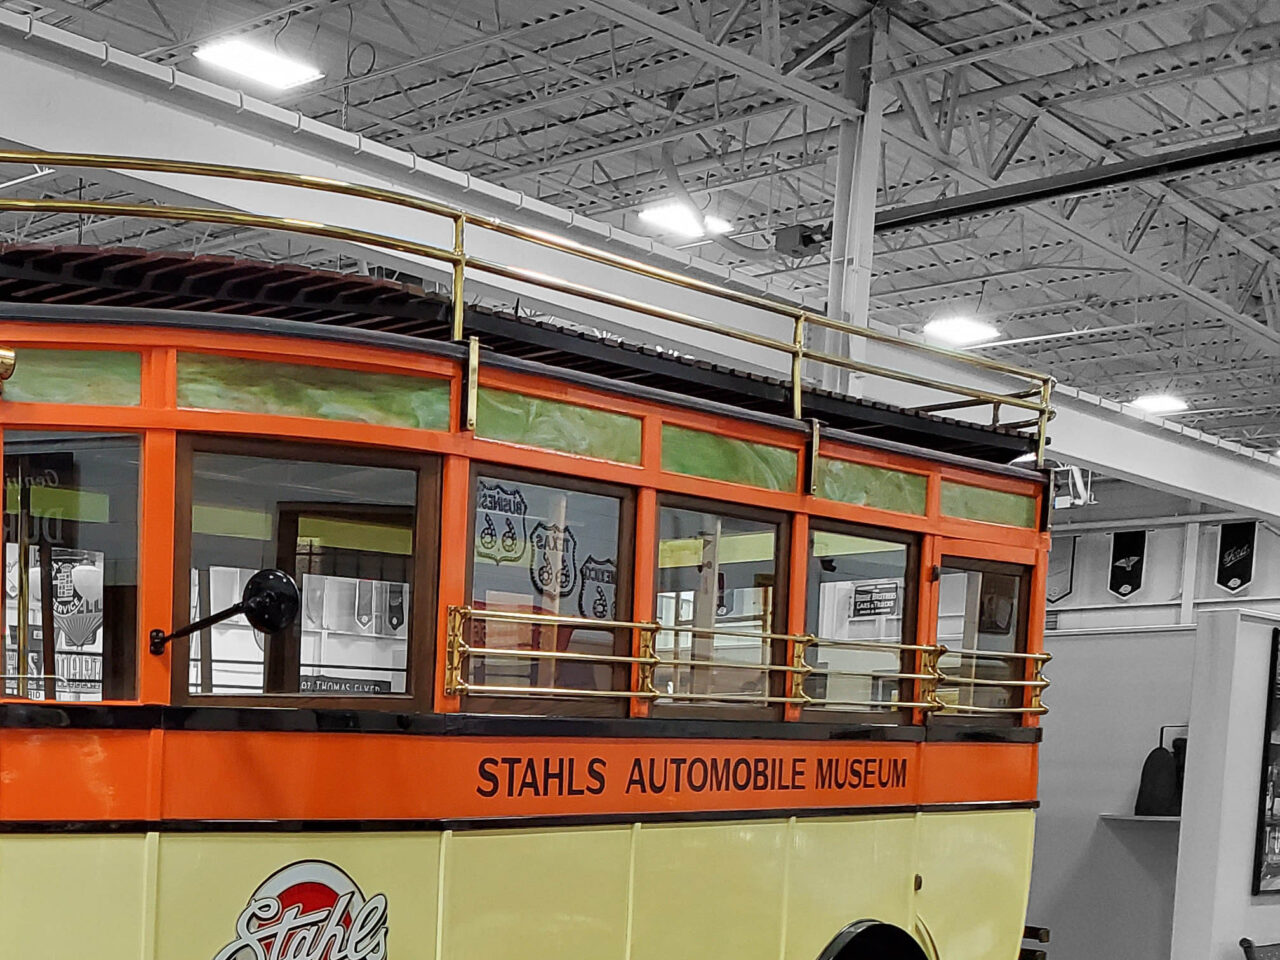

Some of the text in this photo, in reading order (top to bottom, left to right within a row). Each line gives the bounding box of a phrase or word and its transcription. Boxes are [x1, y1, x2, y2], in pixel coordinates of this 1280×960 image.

[874, 600, 894, 608] TRUCKS
[315, 680, 351, 691] THOMAS
[476, 757, 908, 798] STAHLS AUTOMOBILE MUSEUM
